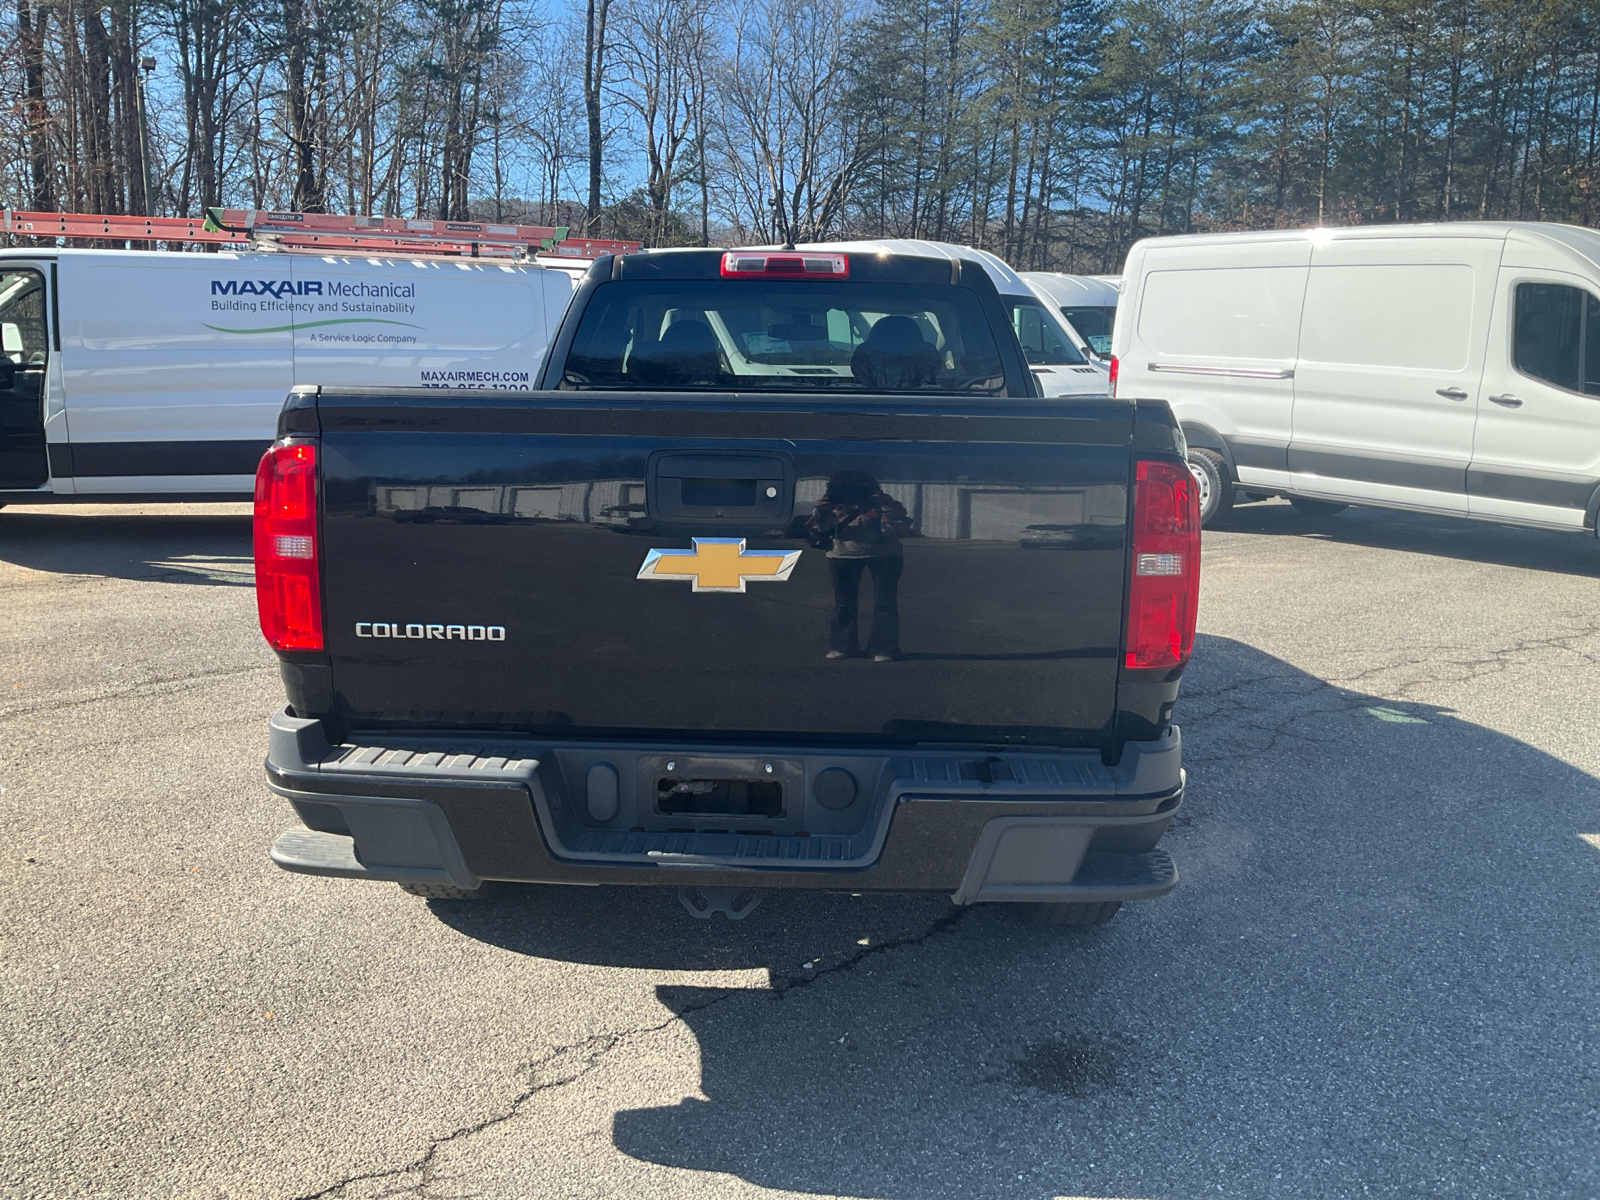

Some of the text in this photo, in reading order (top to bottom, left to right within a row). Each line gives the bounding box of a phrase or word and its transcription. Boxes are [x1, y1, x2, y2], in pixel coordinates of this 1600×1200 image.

[211, 280, 415, 299] MAXAIR Mechanical
[211, 301, 415, 314] Building Efficiency and Sustainability
[318, 333, 350, 342] Service
[352, 334, 376, 343] Logic
[377, 334, 417, 344] Company
[421, 371, 529, 382] MAXAIRMECH.COM
[355, 622, 506, 641] COLORADO
